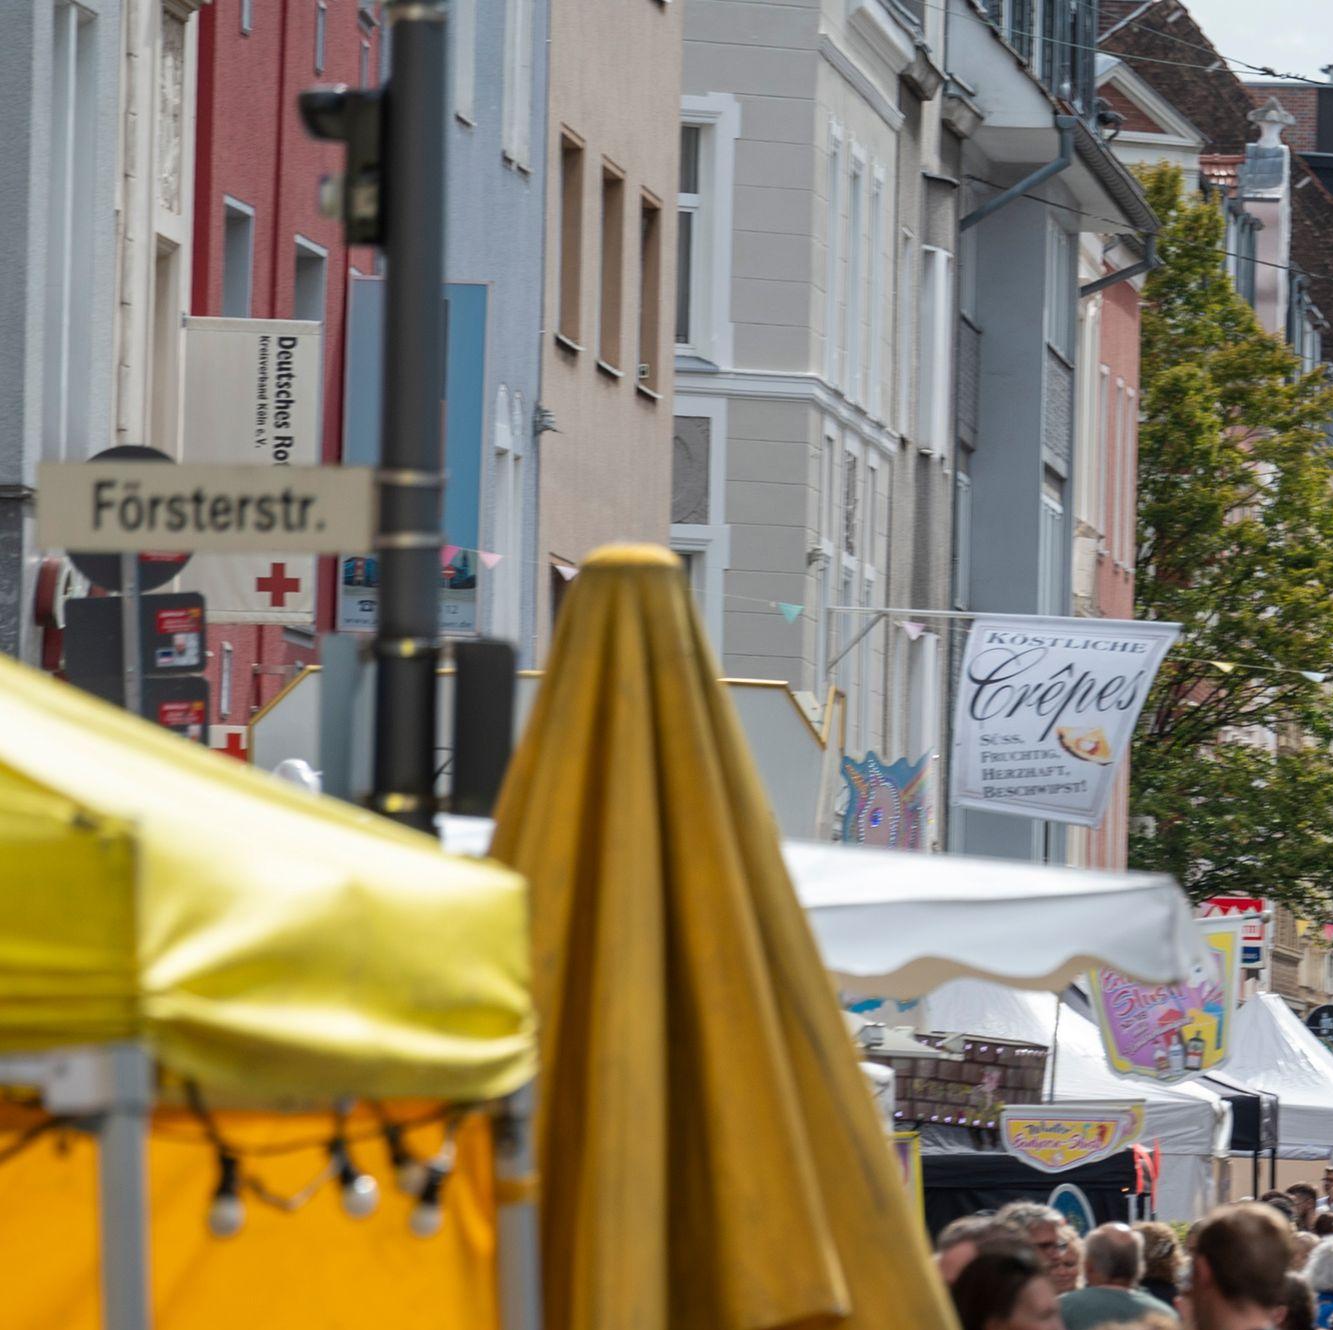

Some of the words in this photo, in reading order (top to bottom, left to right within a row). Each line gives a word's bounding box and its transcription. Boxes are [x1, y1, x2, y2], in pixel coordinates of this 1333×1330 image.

[257, 335, 272, 400] Kreisverband
[273, 336, 298, 429] Deutsches
[255, 403, 268, 426] Köln
[92, 479, 327, 534] Försterstr.
[986, 632, 1148, 654] KÖSTLICHE
[967, 646, 1146, 742] Crêpes
